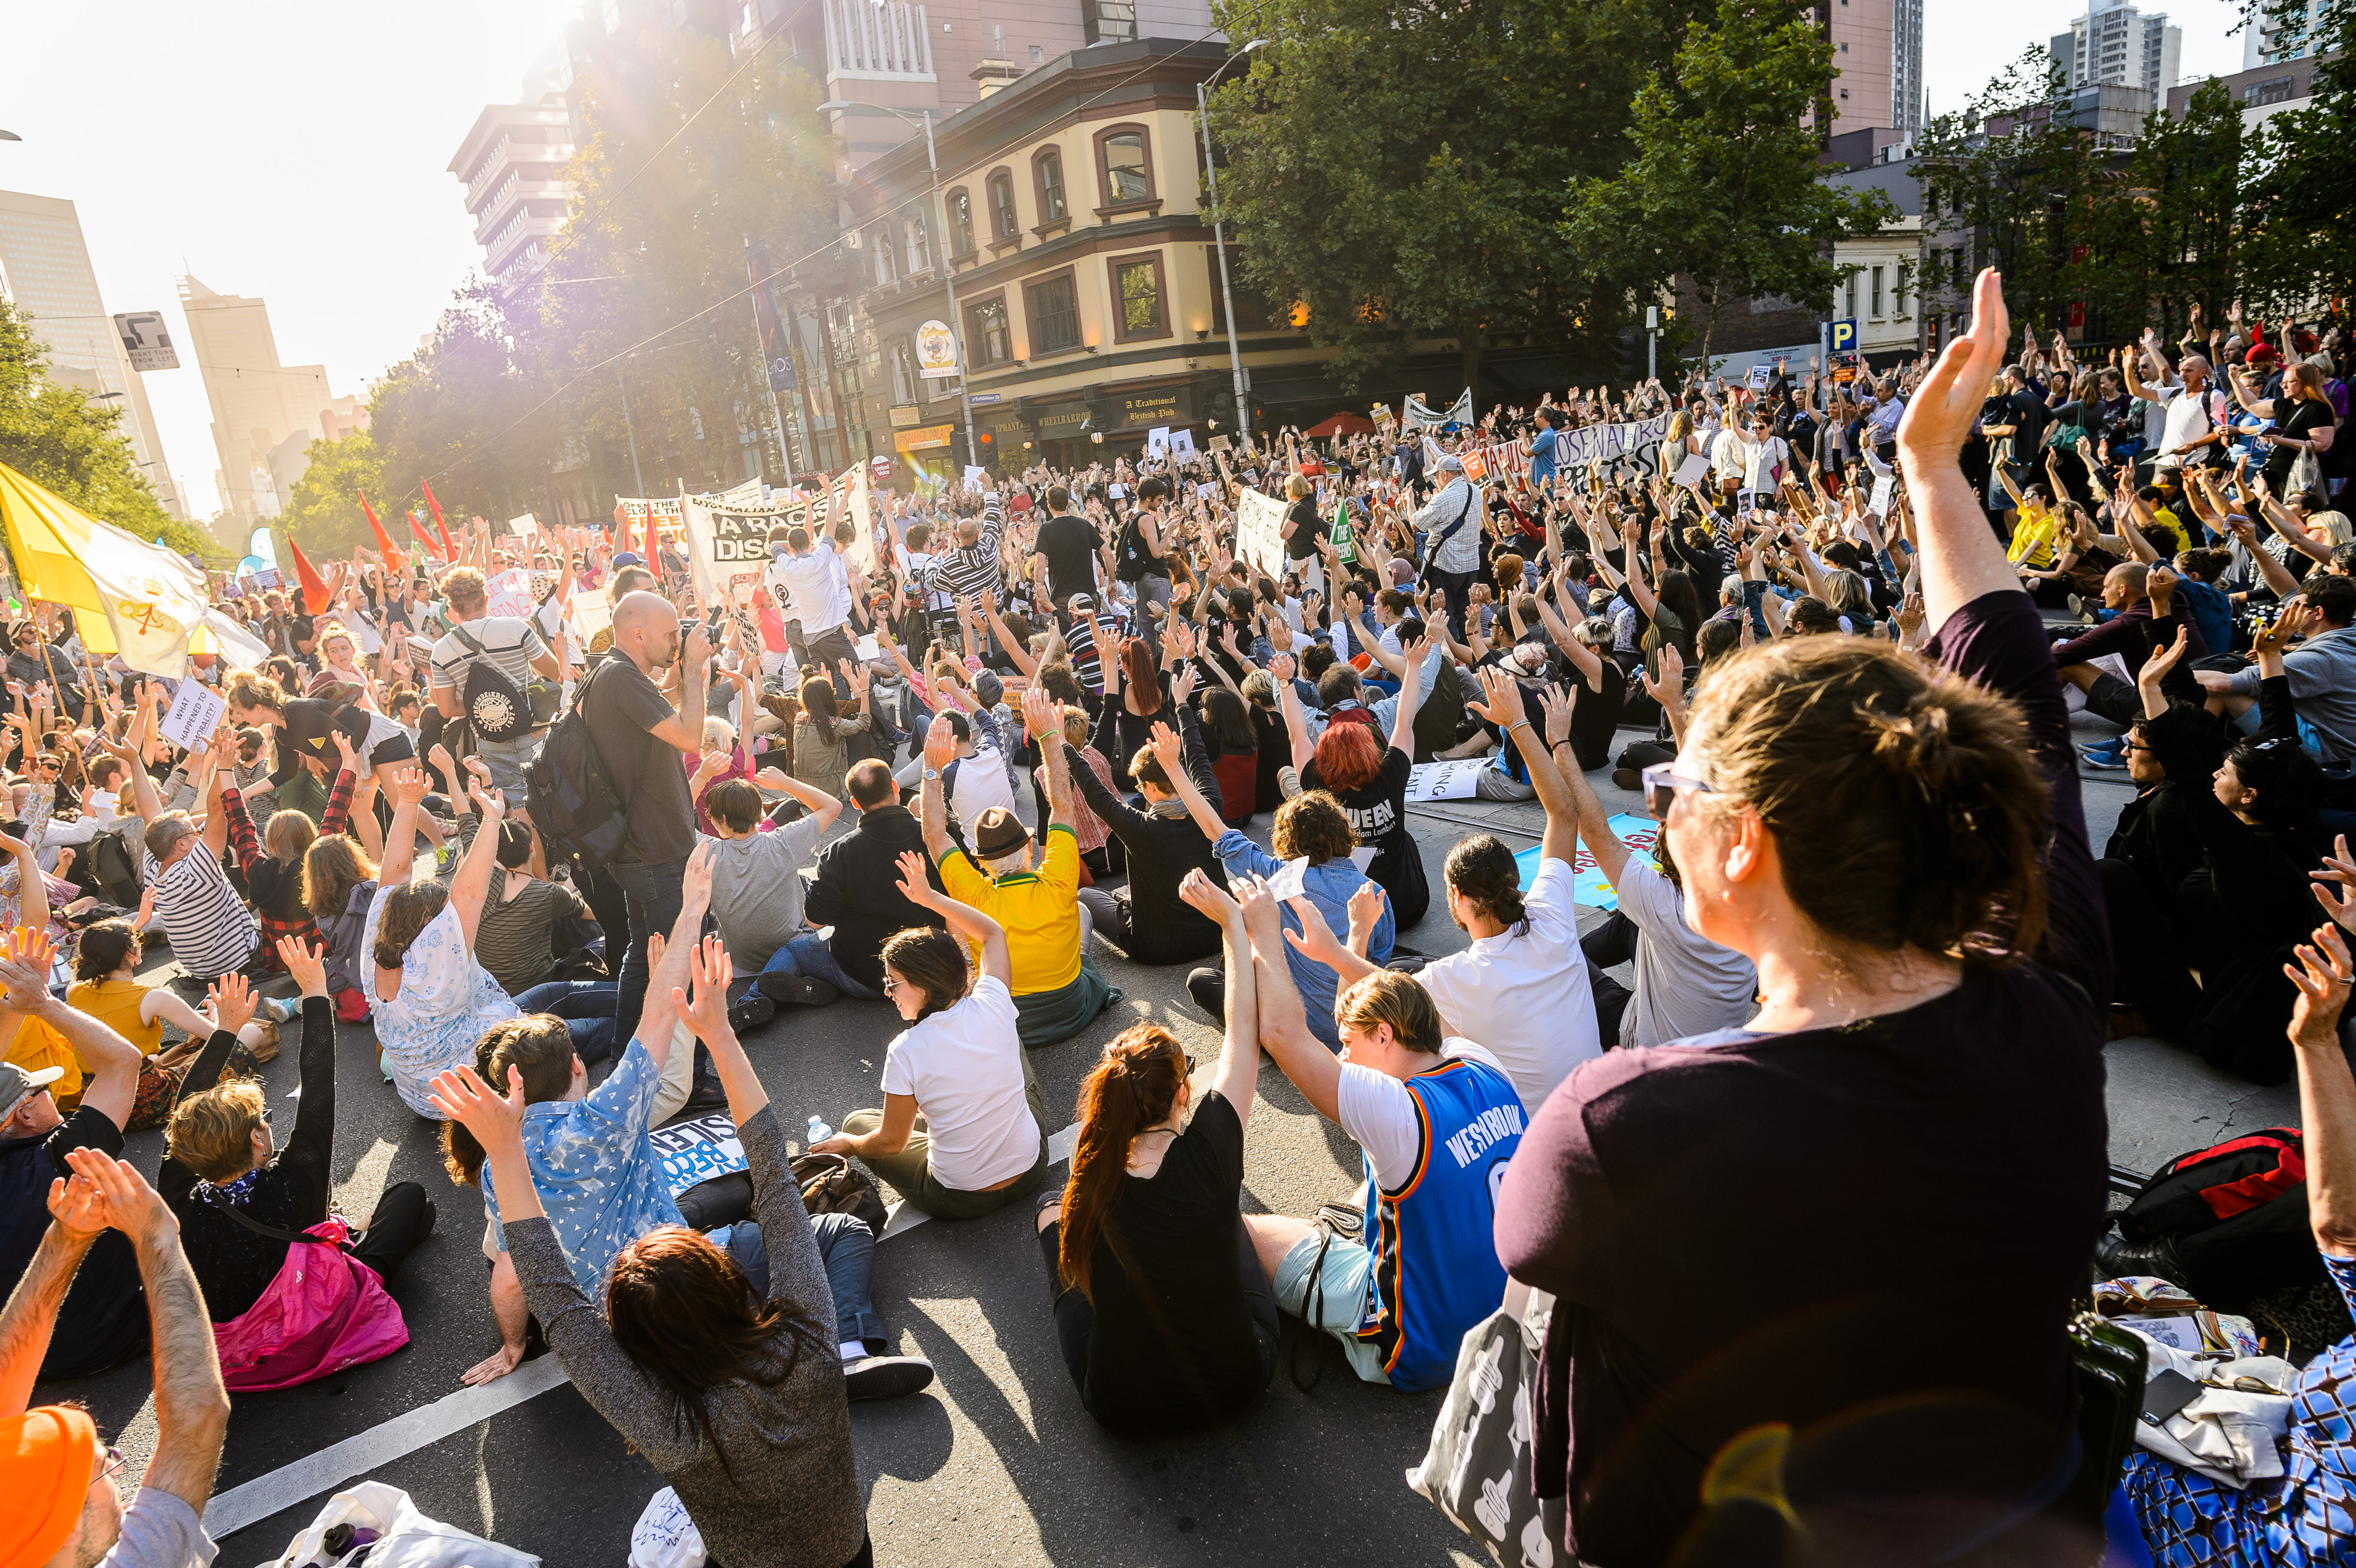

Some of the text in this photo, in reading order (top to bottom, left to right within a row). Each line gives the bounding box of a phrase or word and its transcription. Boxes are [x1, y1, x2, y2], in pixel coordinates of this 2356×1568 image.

[1834, 324, 1853, 350] P
[1126, 396, 1176, 409] A Traditional
[1130, 409, 1174, 421] British Pub
[719, 515, 743, 535] A
[1337, 524, 1348, 542] THE
[737, 605, 748, 621] WE
[736, 616, 757, 637] STAND
[740, 628, 760, 649] WITH
[743, 639, 762, 660] YOU!
[174, 696, 190, 720] WHAT
[180, 692, 207, 742] HAPPENED TO
[193, 703, 216, 743] MORALITY?
[1355, 821, 1396, 838] dam Lambert
[1374, 848, 1385, 857] 014
